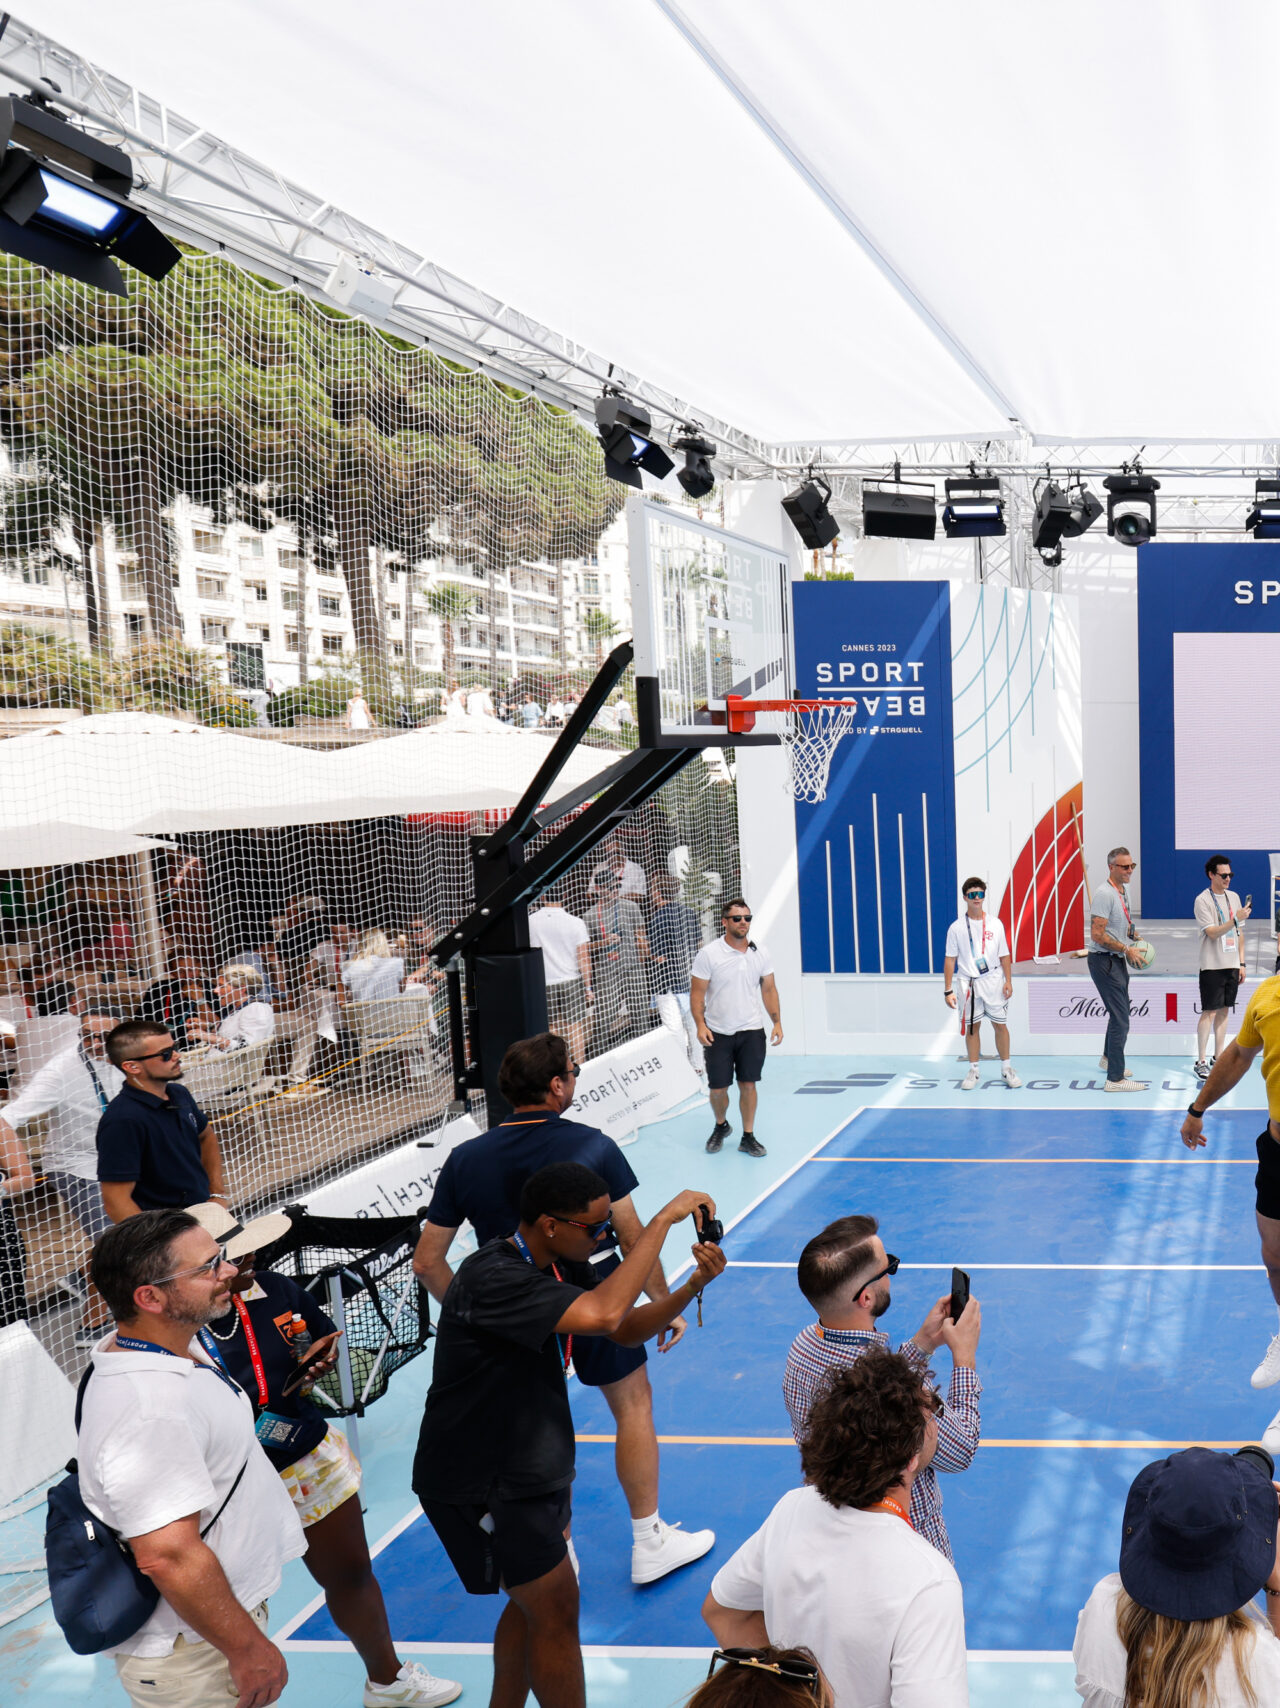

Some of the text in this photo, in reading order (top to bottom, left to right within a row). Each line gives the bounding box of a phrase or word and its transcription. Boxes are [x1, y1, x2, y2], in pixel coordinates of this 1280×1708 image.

[841, 644, 897, 652] CANNES 2023
[816, 662, 924, 683] SPORT
[857, 727, 867, 735] BY
[620, 1056, 663, 1087] BEACH
[572, 1079, 617, 1113] SPORT
[363, 1242, 412, 1279] Wilson
